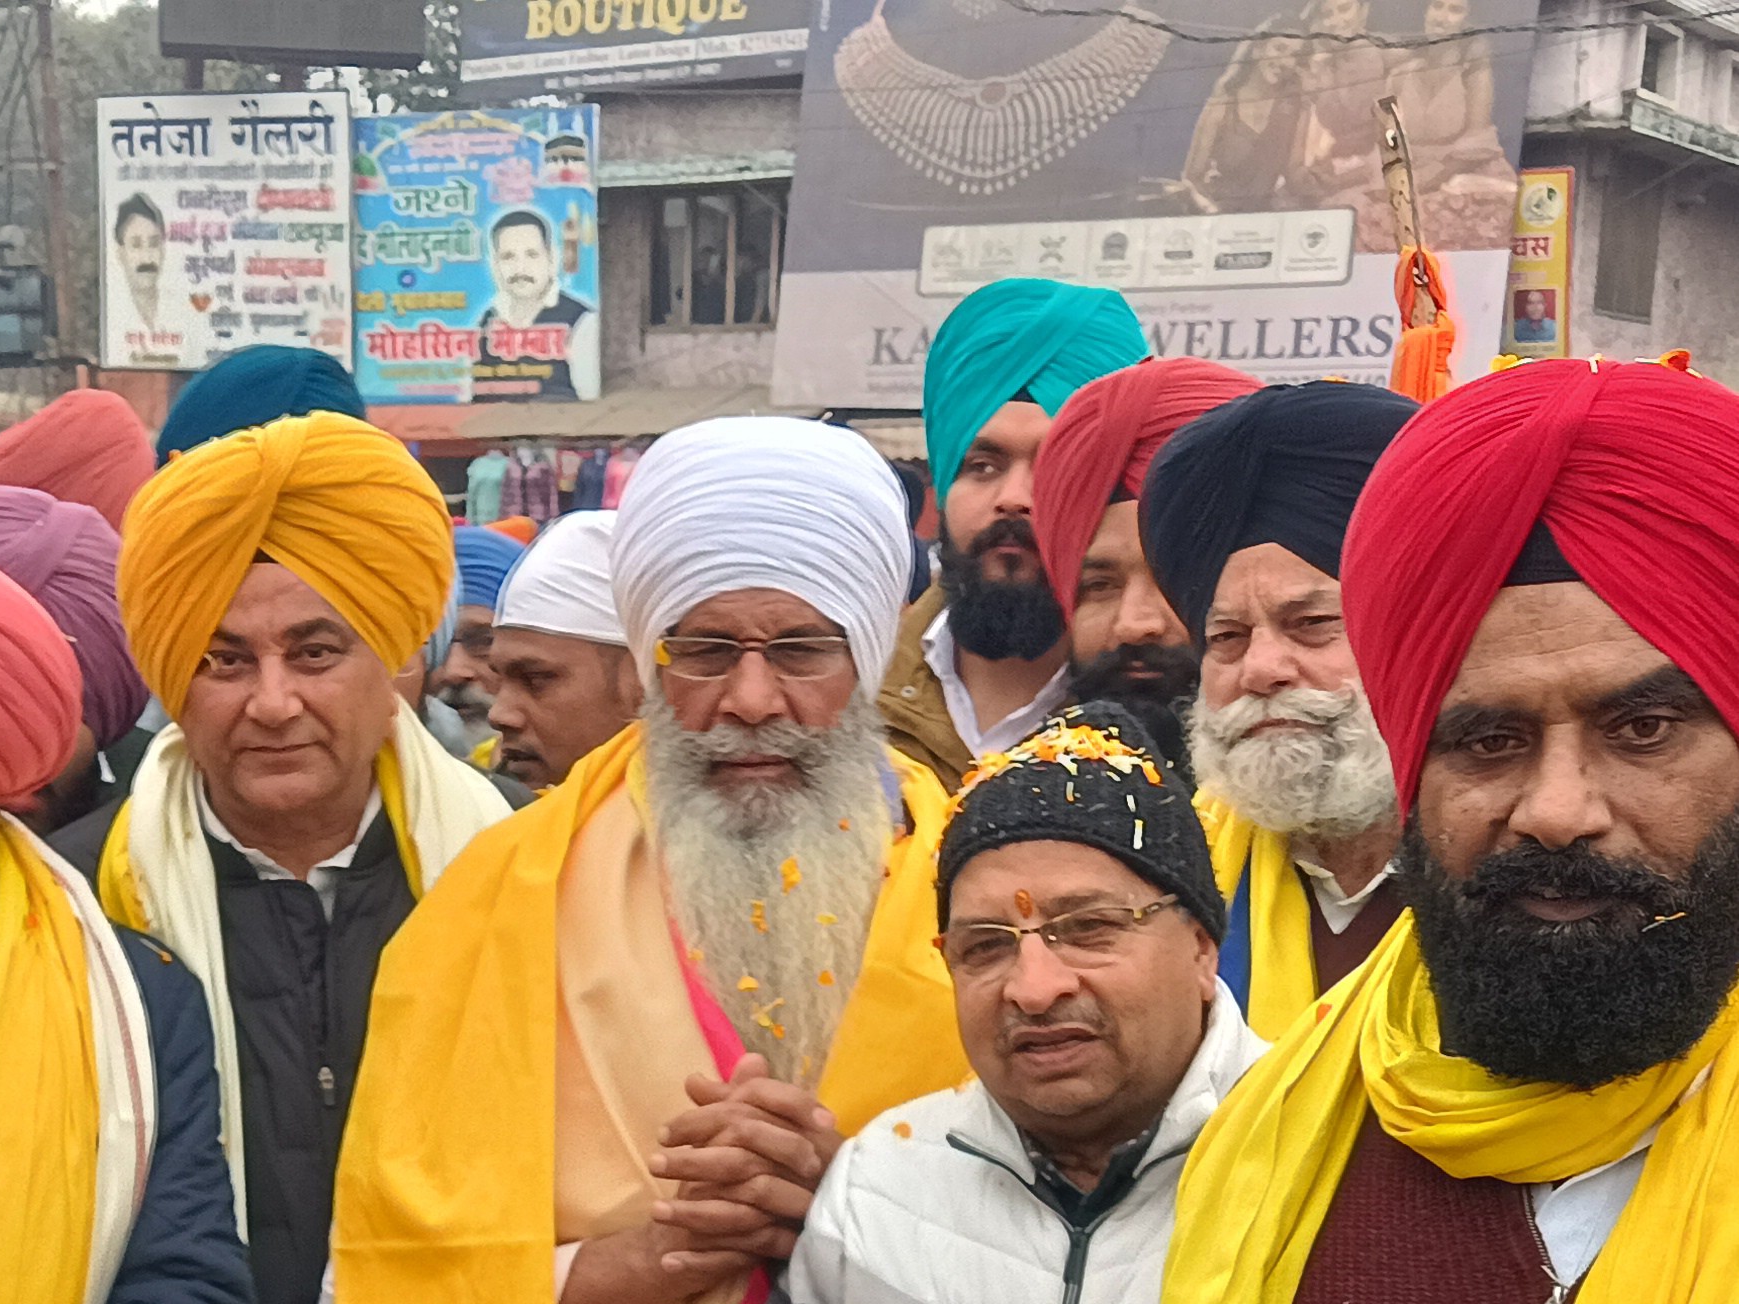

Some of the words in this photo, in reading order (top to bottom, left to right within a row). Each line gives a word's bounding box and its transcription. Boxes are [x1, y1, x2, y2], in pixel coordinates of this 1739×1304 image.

[525, 0, 748, 39] BOUTIQUE
[110, 102, 211, 159] तनेजा
[366, 323, 479, 360] मोहसिन
[867, 325, 930, 366] KA
[1142, 314, 1394, 361] WELLERS
